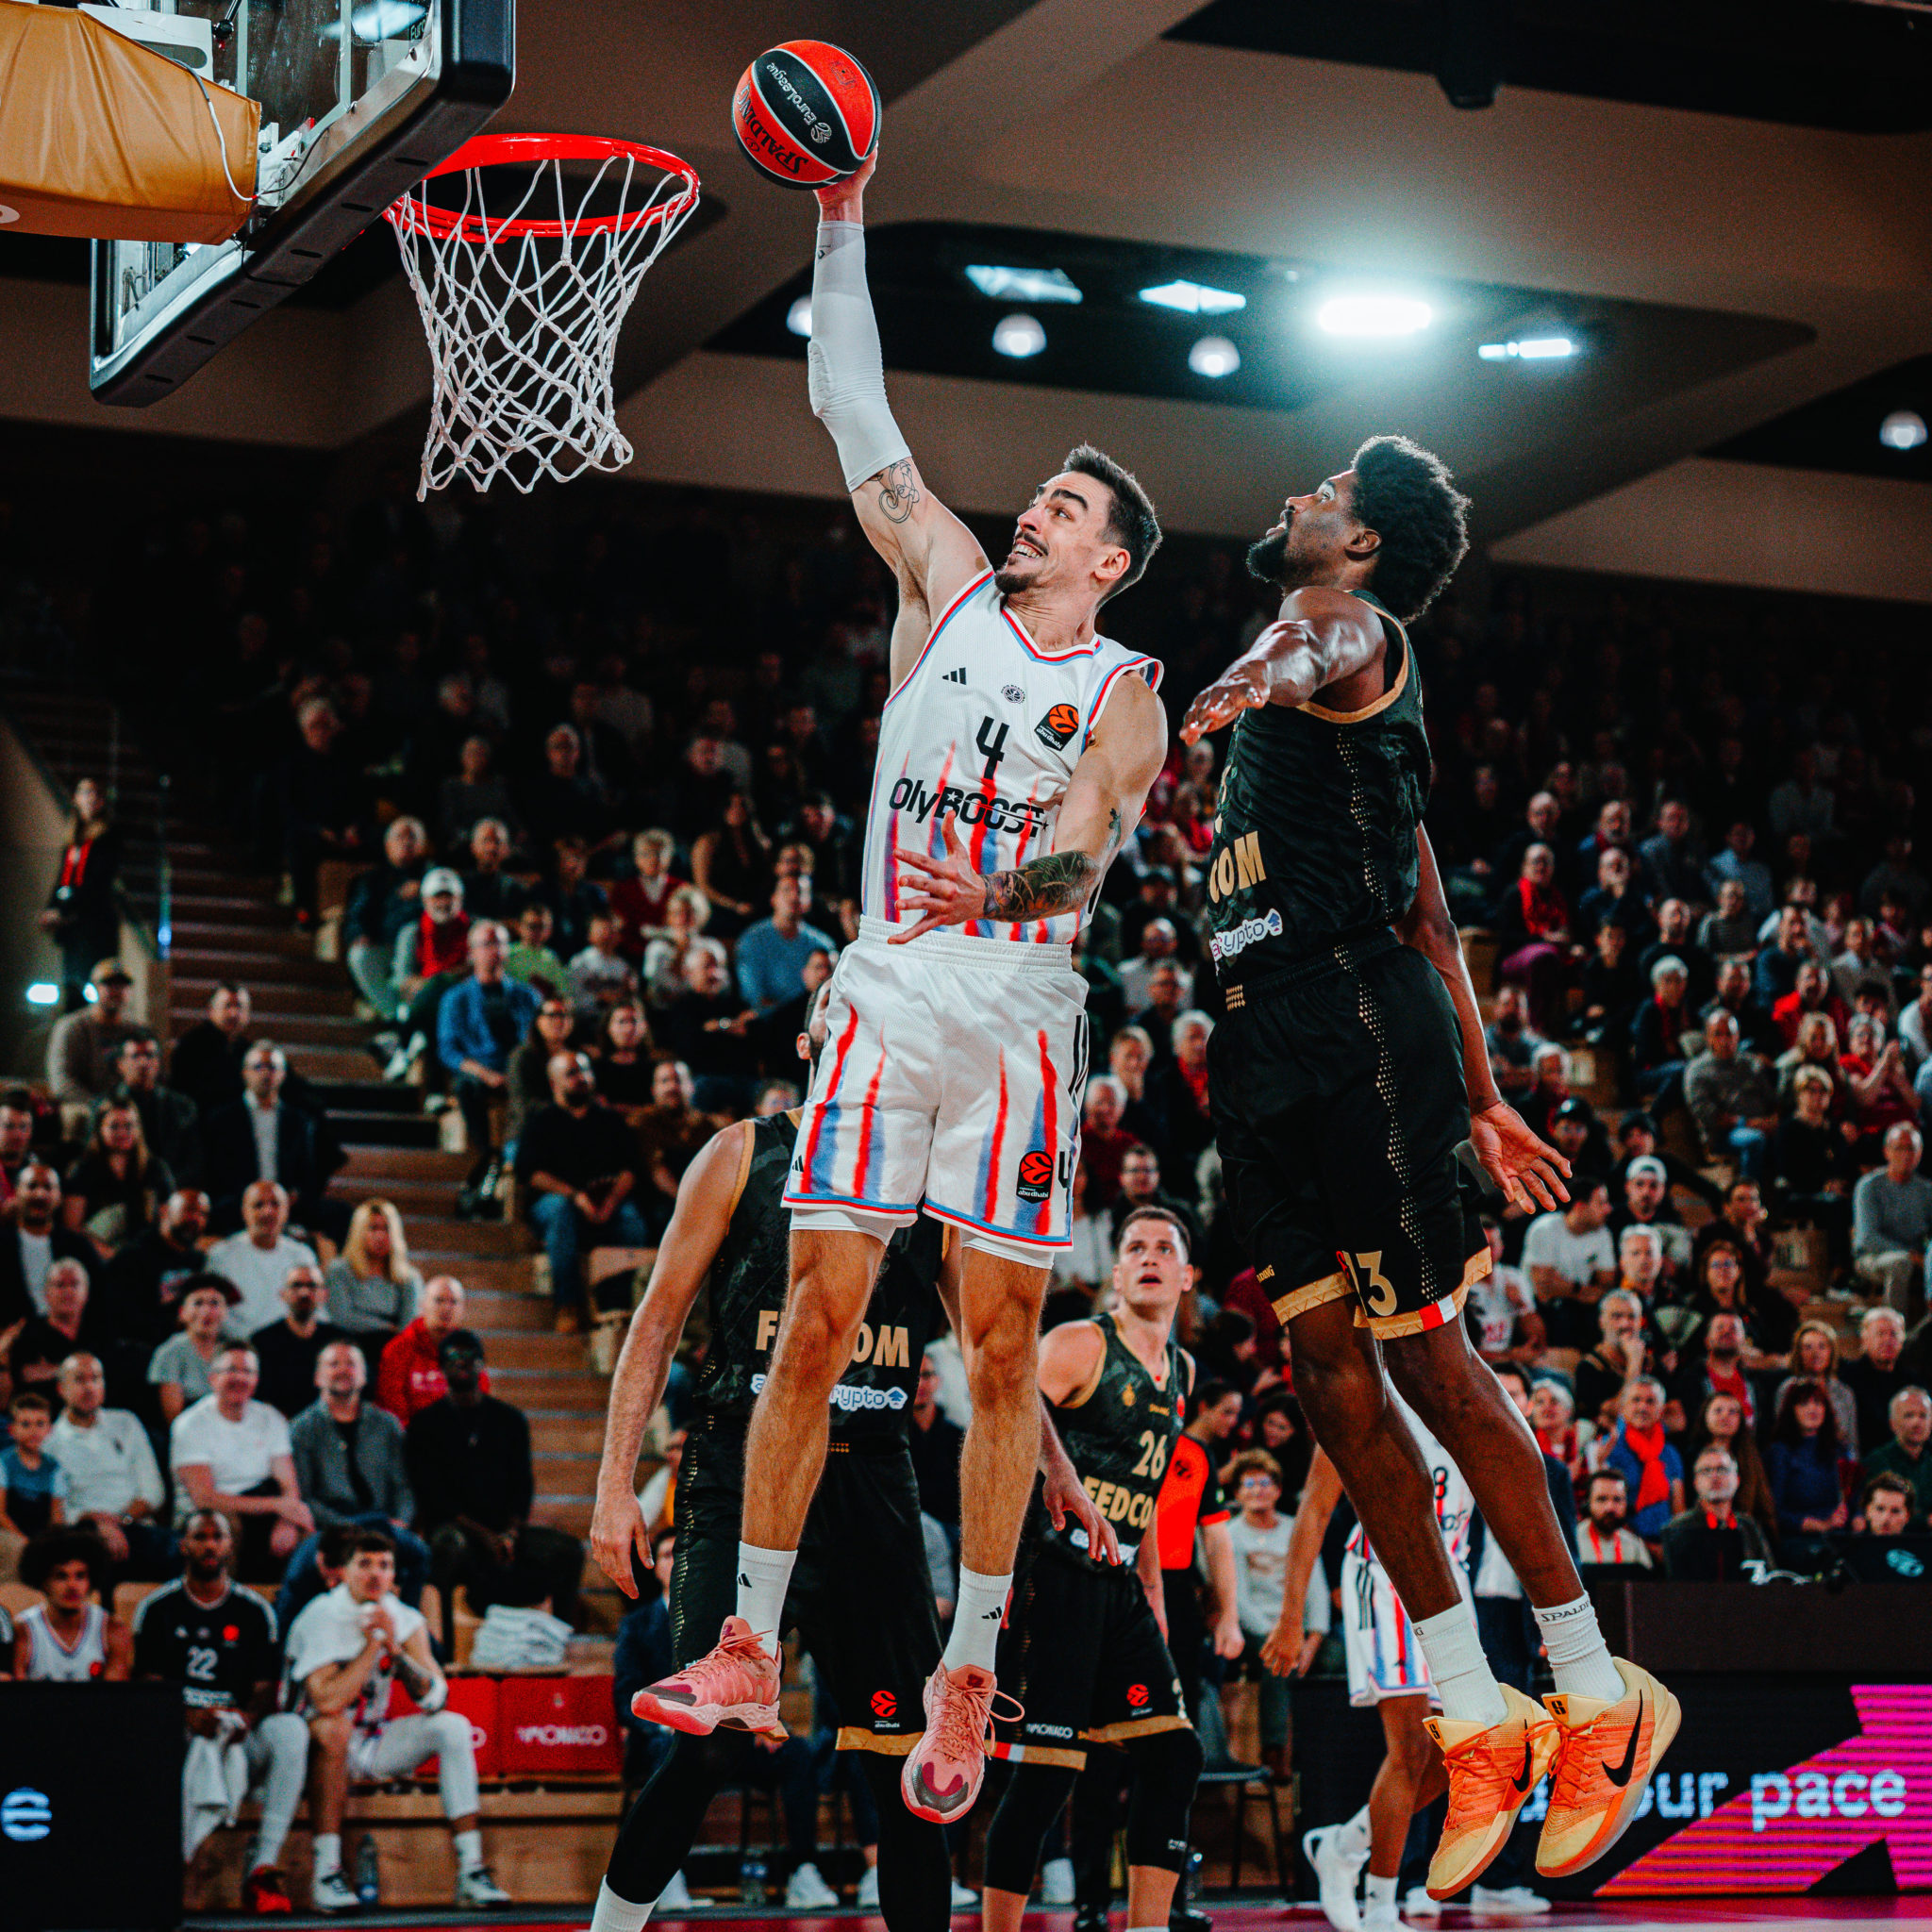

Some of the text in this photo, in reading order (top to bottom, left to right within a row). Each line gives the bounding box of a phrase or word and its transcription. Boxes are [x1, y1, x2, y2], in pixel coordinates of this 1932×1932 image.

[766, 62, 817, 125] EuroLeague
[737, 81, 809, 175] SPALDING
[975, 715, 1010, 780] 4
[889, 777, 1046, 838] OlyBOOST
[1132, 1429, 1168, 1480] 26
[188, 1645, 218, 1681] 22
[1750, 1768, 1907, 1833] pace
